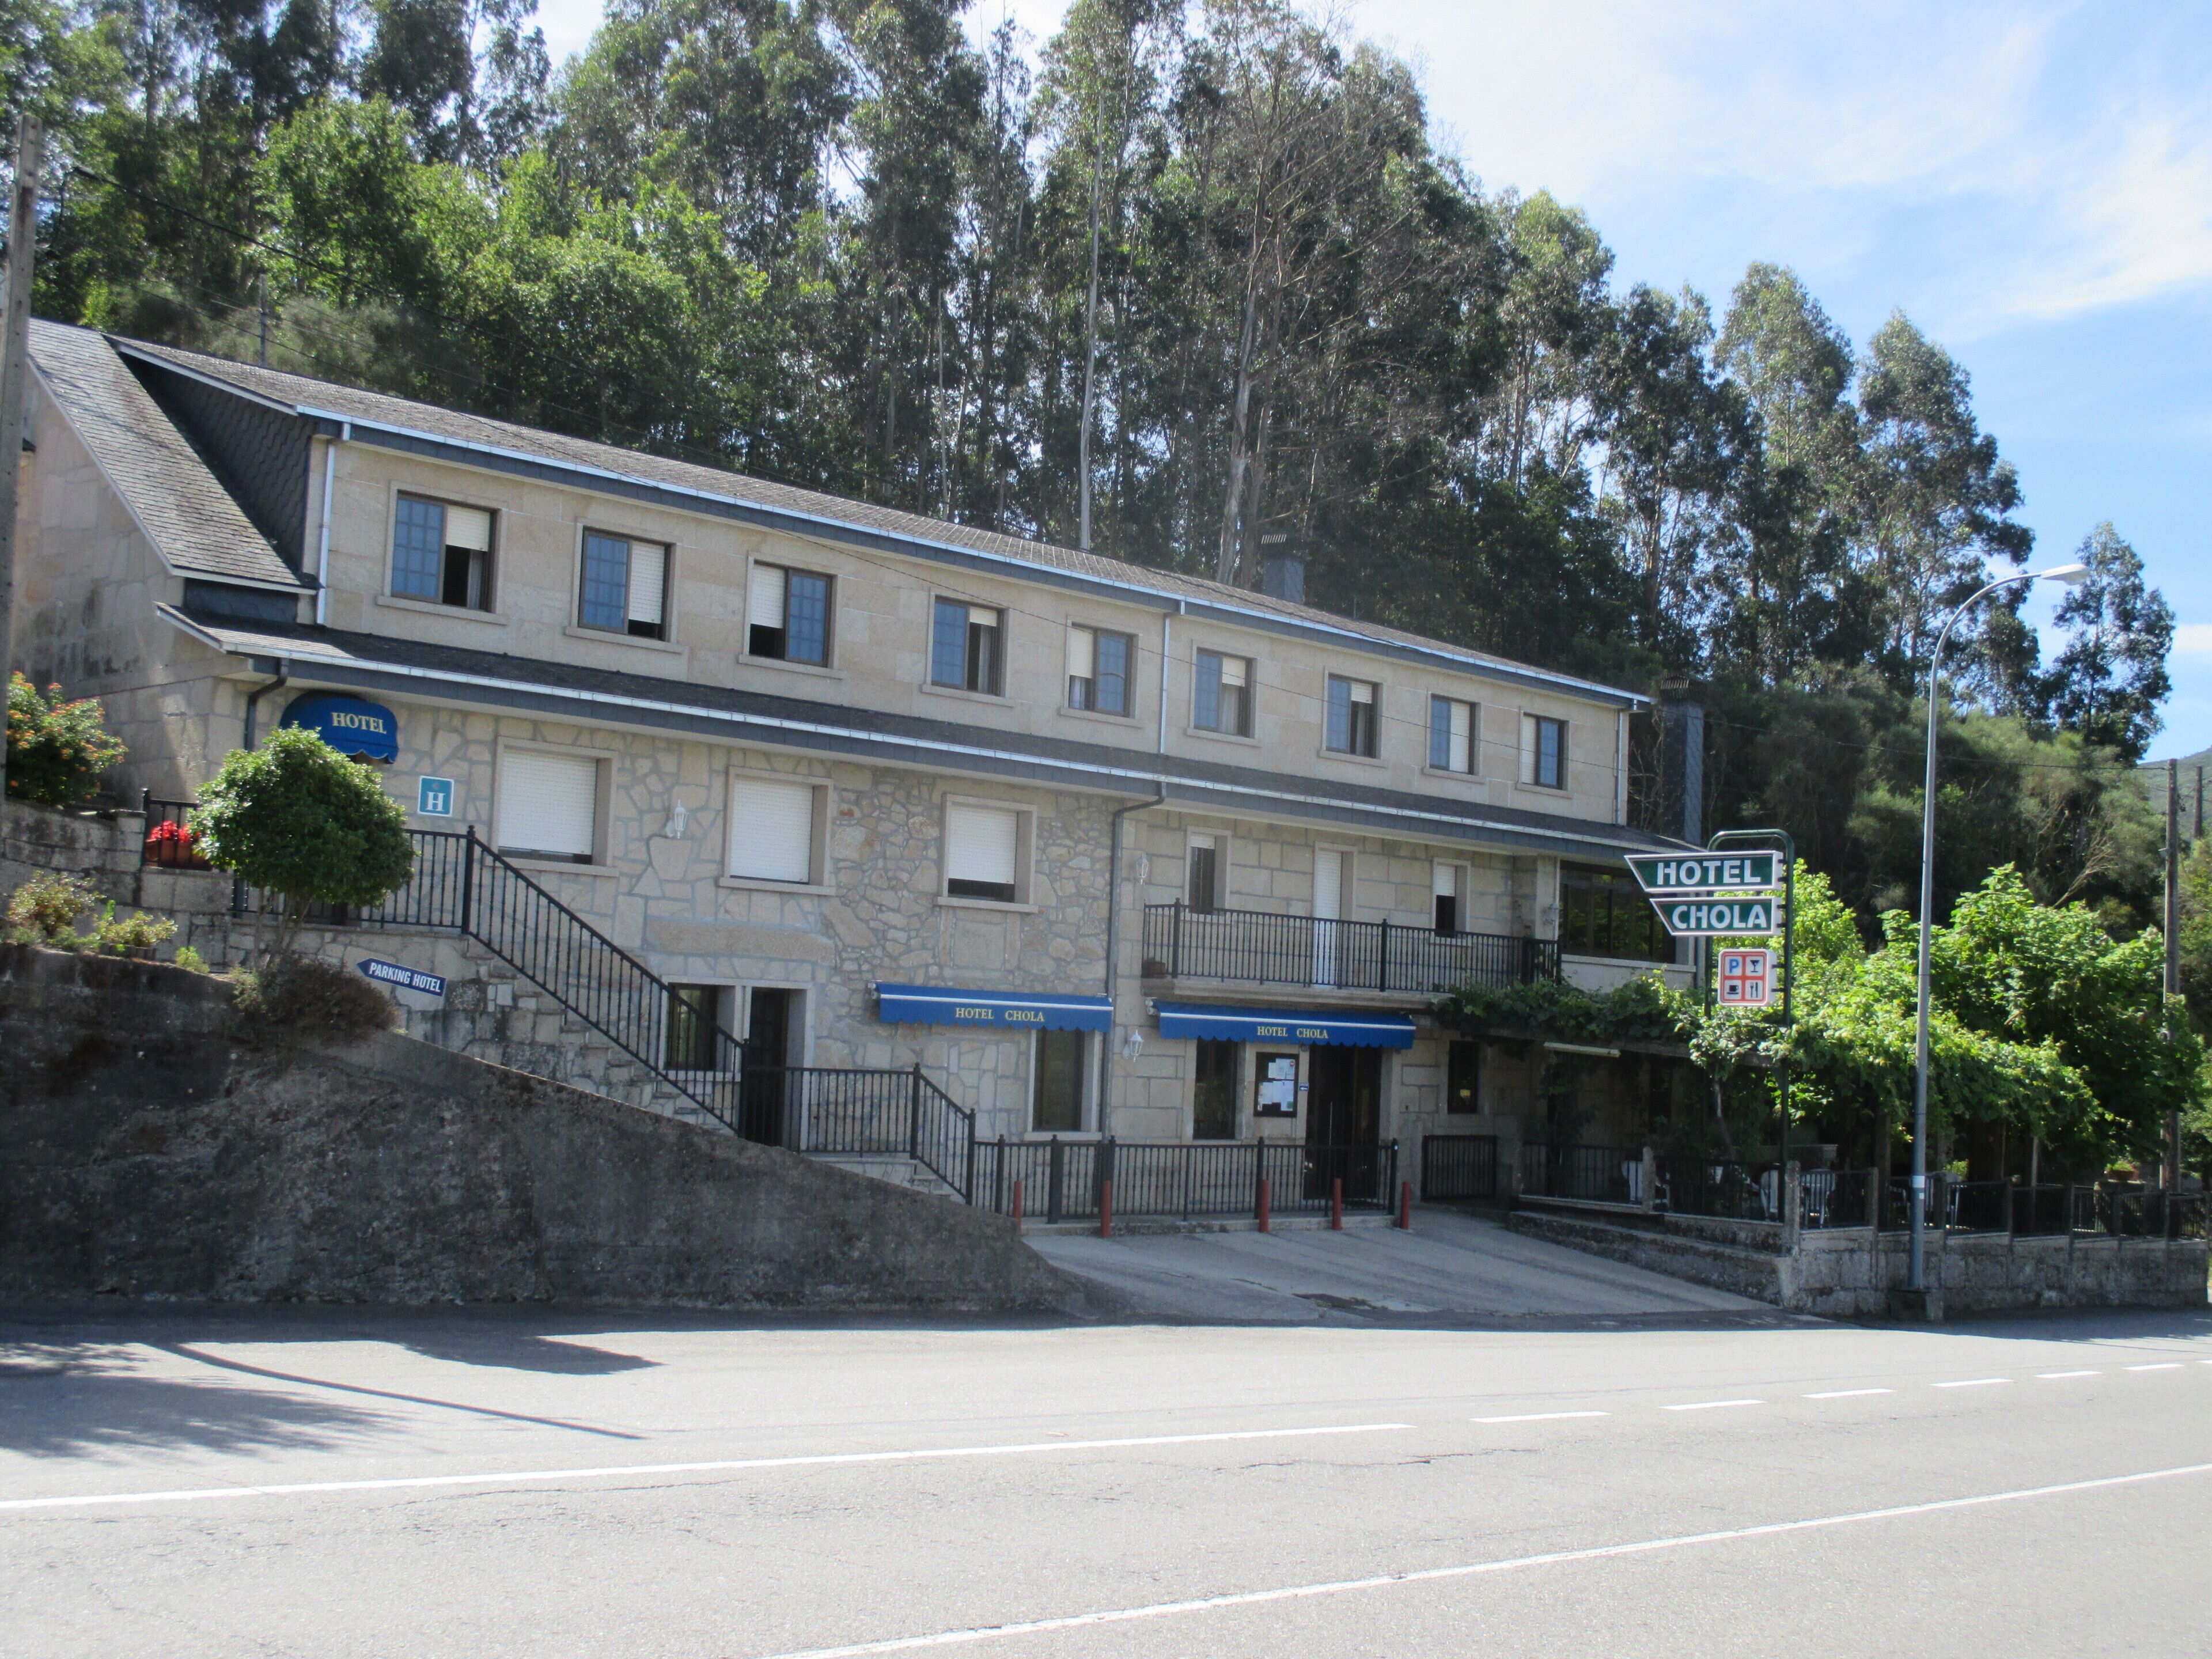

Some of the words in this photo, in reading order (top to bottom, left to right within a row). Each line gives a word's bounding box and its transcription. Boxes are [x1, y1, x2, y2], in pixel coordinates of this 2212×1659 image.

[331, 712, 387, 734] HOTEL
[426, 791, 445, 812] H
[1657, 860, 1762, 885] HOTEL
[1672, 904, 1767, 929] CHOLA
[1729, 959, 1739, 974] P
[369, 962, 411, 984] PARKING
[412, 974, 441, 993] HOTEL
[956, 1007, 994, 1019] HOTEL
[1005, 1010, 1044, 1022] CHOLA
[1257, 1026, 1288, 1036] HOTEL
[1297, 1028, 1328, 1039] CHOLA
